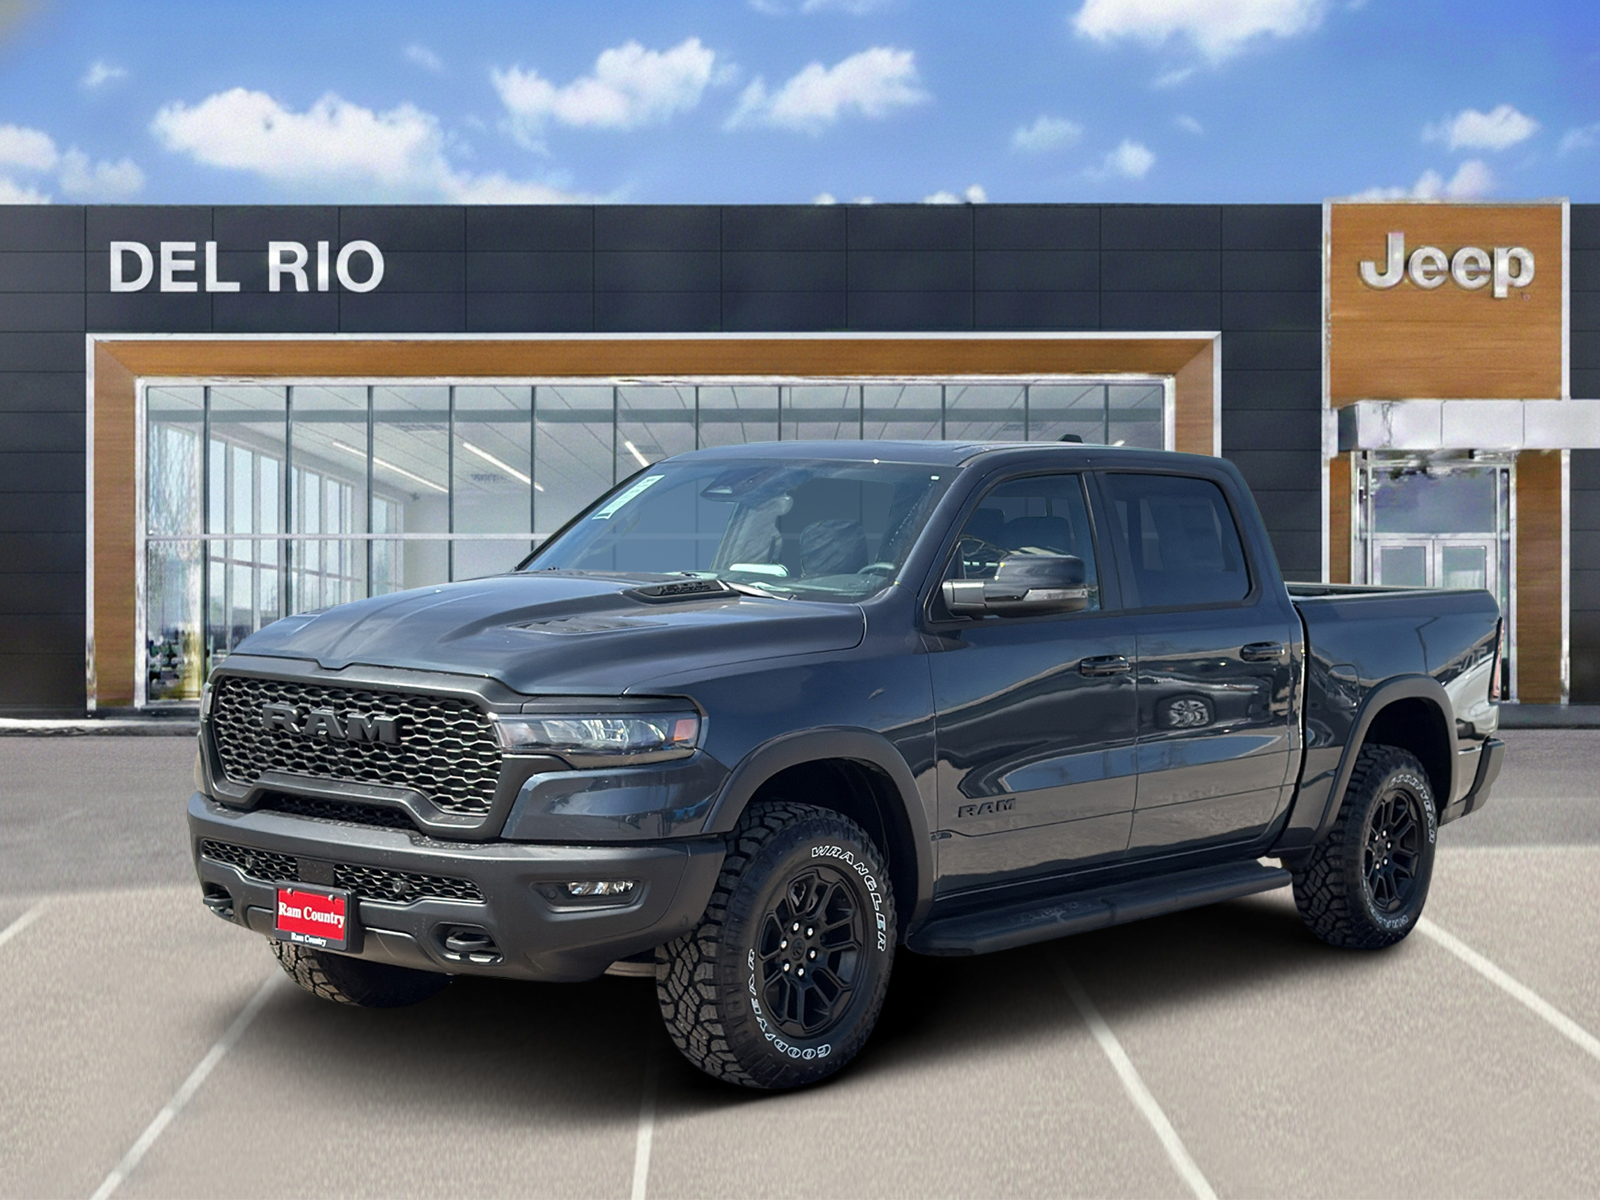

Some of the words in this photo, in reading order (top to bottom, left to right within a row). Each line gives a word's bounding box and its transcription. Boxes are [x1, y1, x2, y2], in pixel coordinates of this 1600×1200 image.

[110, 241, 240, 292] DEL
[268, 240, 384, 293] RIO
[1359, 231, 1535, 298] Jeep
[262, 701, 397, 744] RAM
[958, 798, 1016, 818] RAM
[278, 902, 302, 918] Ram
[303, 906, 345, 929] Country
[811, 845, 887, 951] WRANGLER
[748, 948, 832, 1060] GOODYEAR
